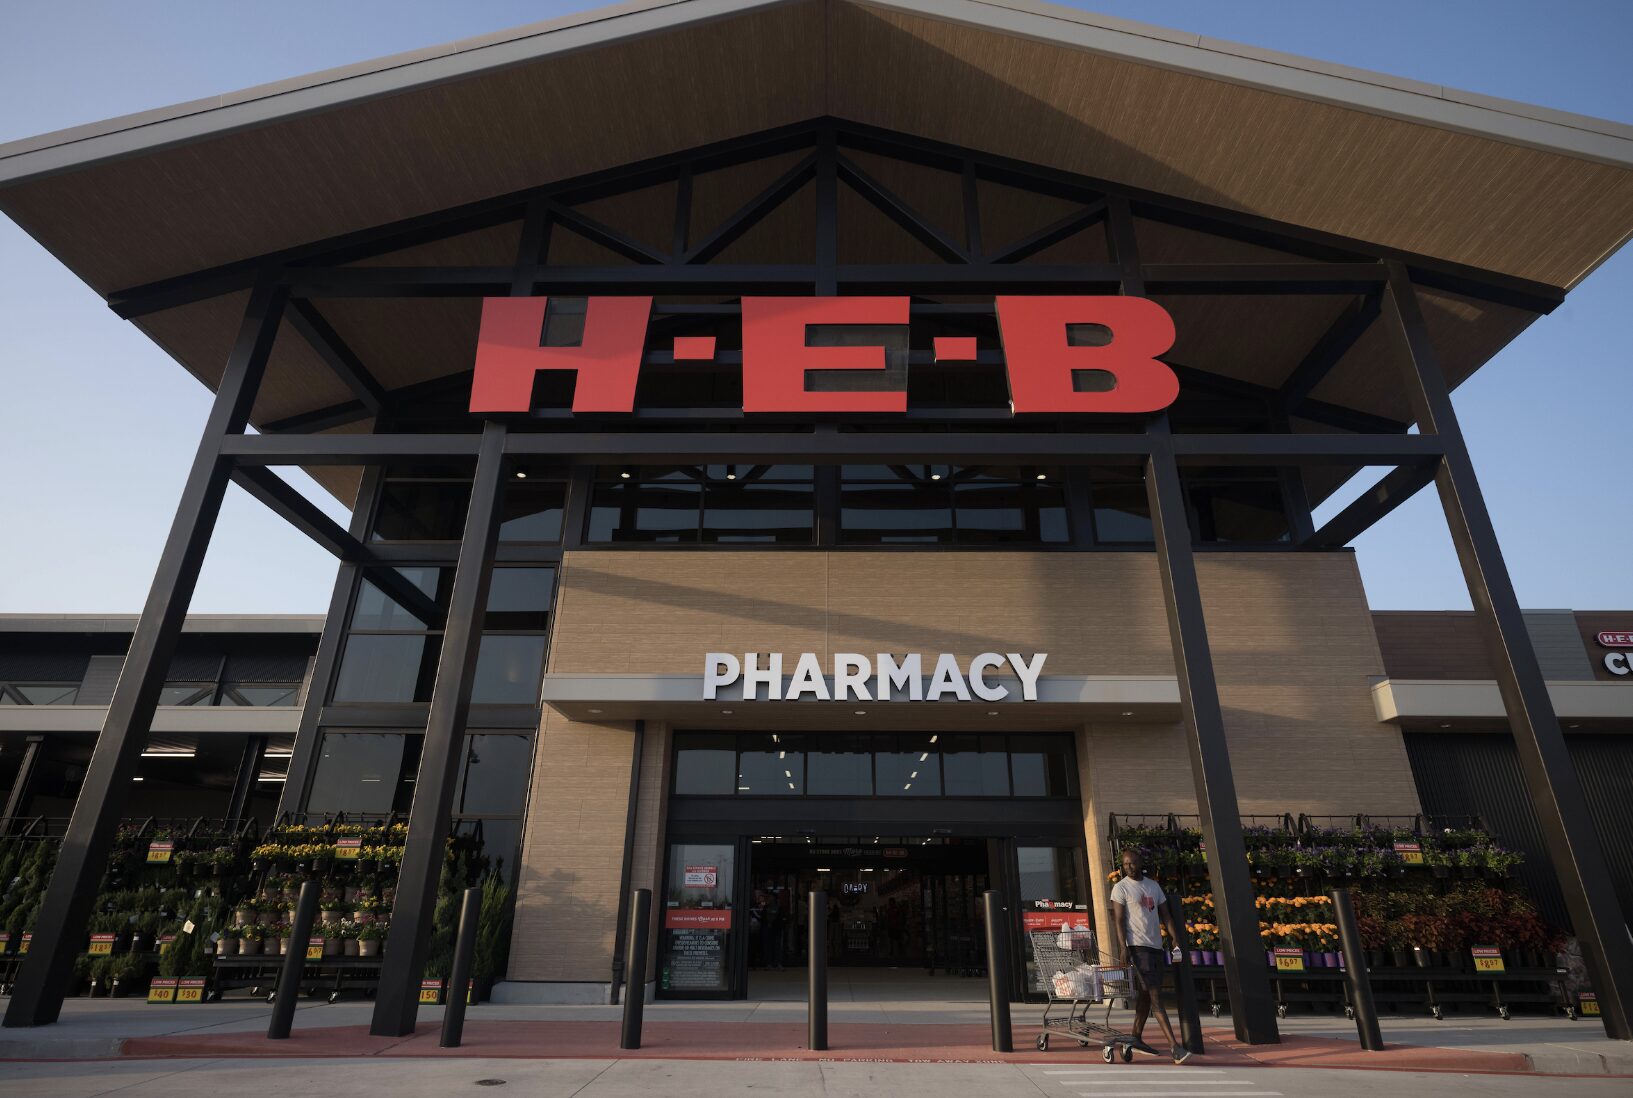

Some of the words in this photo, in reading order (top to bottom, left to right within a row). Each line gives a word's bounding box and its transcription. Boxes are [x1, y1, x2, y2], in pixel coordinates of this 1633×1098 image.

[703, 652, 1048, 701] PHARMACY
[154, 990, 169, 999] $40
[182, 990, 197, 999] $30
